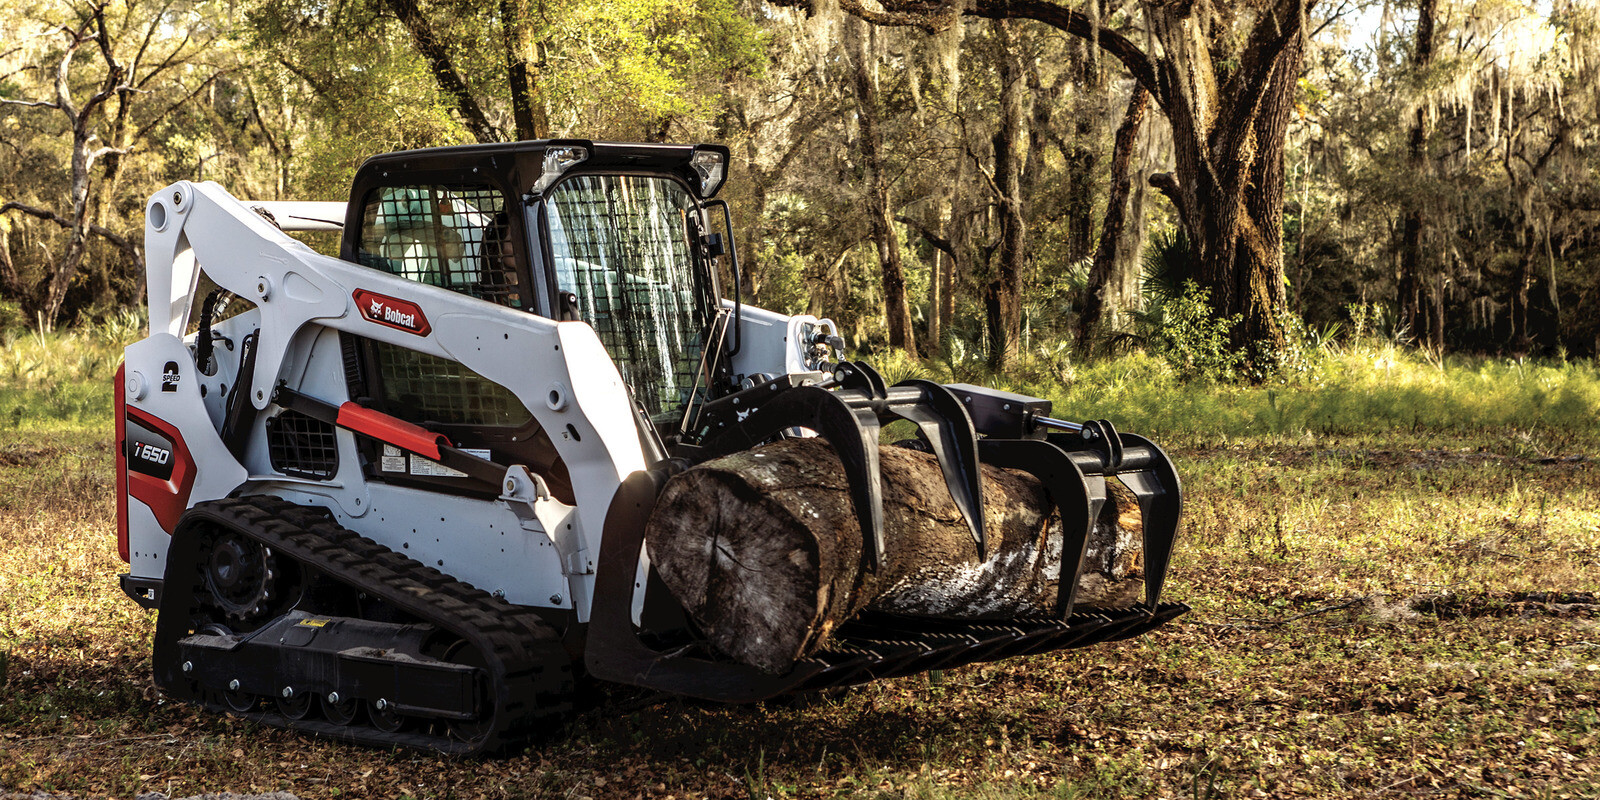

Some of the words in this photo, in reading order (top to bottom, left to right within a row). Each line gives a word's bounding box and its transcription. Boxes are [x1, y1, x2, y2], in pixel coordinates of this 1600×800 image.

[384, 306, 415, 328] Bobcat
[162, 360, 179, 392] 2
[163, 374, 181, 382] SPEED
